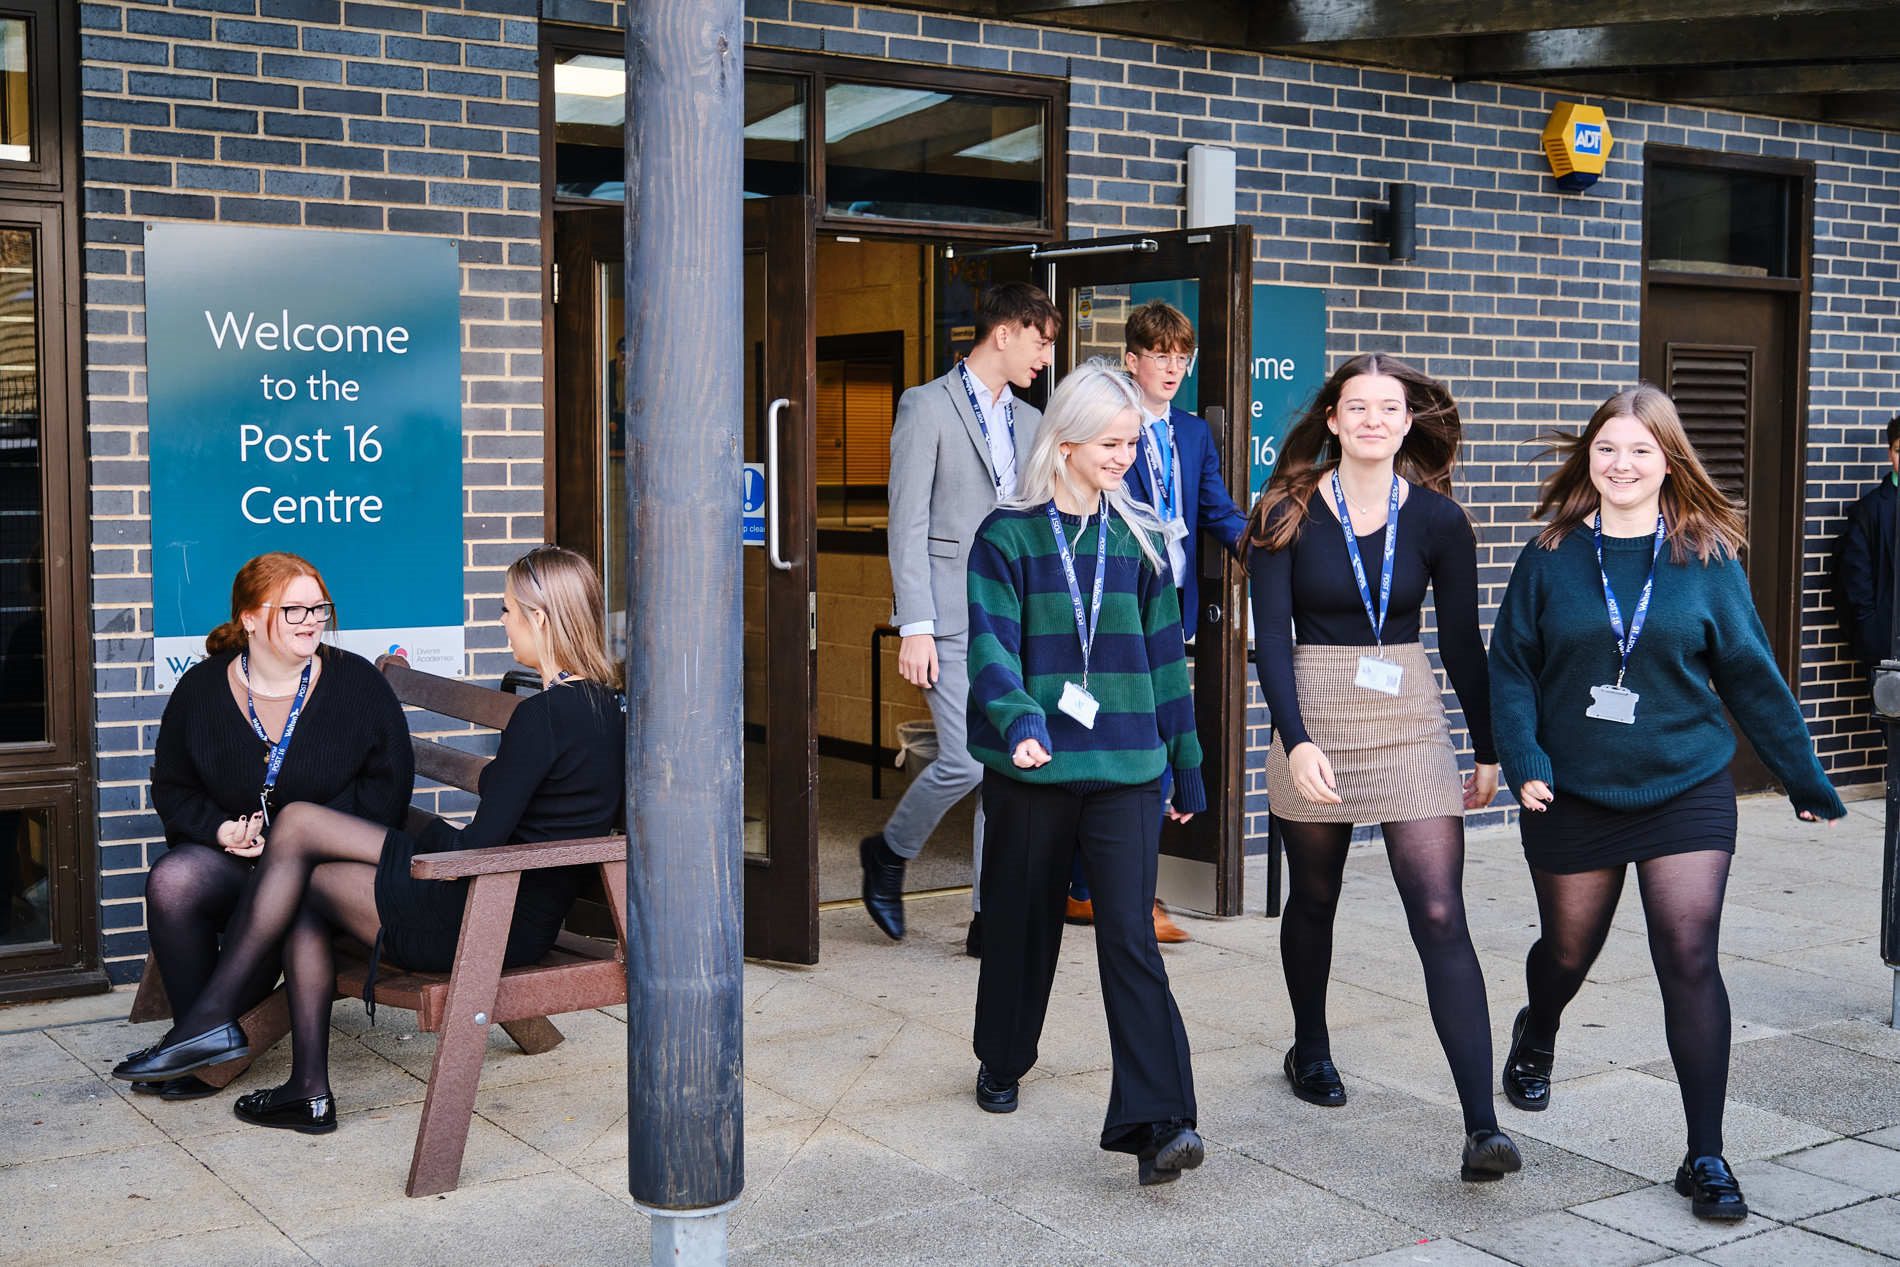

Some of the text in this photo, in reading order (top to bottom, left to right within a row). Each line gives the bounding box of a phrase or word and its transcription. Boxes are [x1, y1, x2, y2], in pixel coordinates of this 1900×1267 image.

[1575, 130, 1601, 149] ADT
[205, 309, 410, 354] Welcome
[260, 370, 360, 401] to the
[240, 424, 382, 462] Post 16
[1251, 436, 1276, 466] 16
[241, 486, 383, 524] Centre
[1047, 507, 1062, 534] POST 16
[1343, 524, 1354, 542] POST
[1063, 555, 1076, 583] Walton
[1092, 577, 1101, 604] Walton
[1072, 597, 1085, 625] POST 16
[1607, 597, 1618, 616] POST
[1625, 624, 1640, 653] POST 16
[298, 676, 308, 697] POST 16
[252, 717, 265, 739] Walton
[284, 715, 297, 738] Walton
[271, 755, 282, 771] POST
[277, 747, 285, 756] 16
